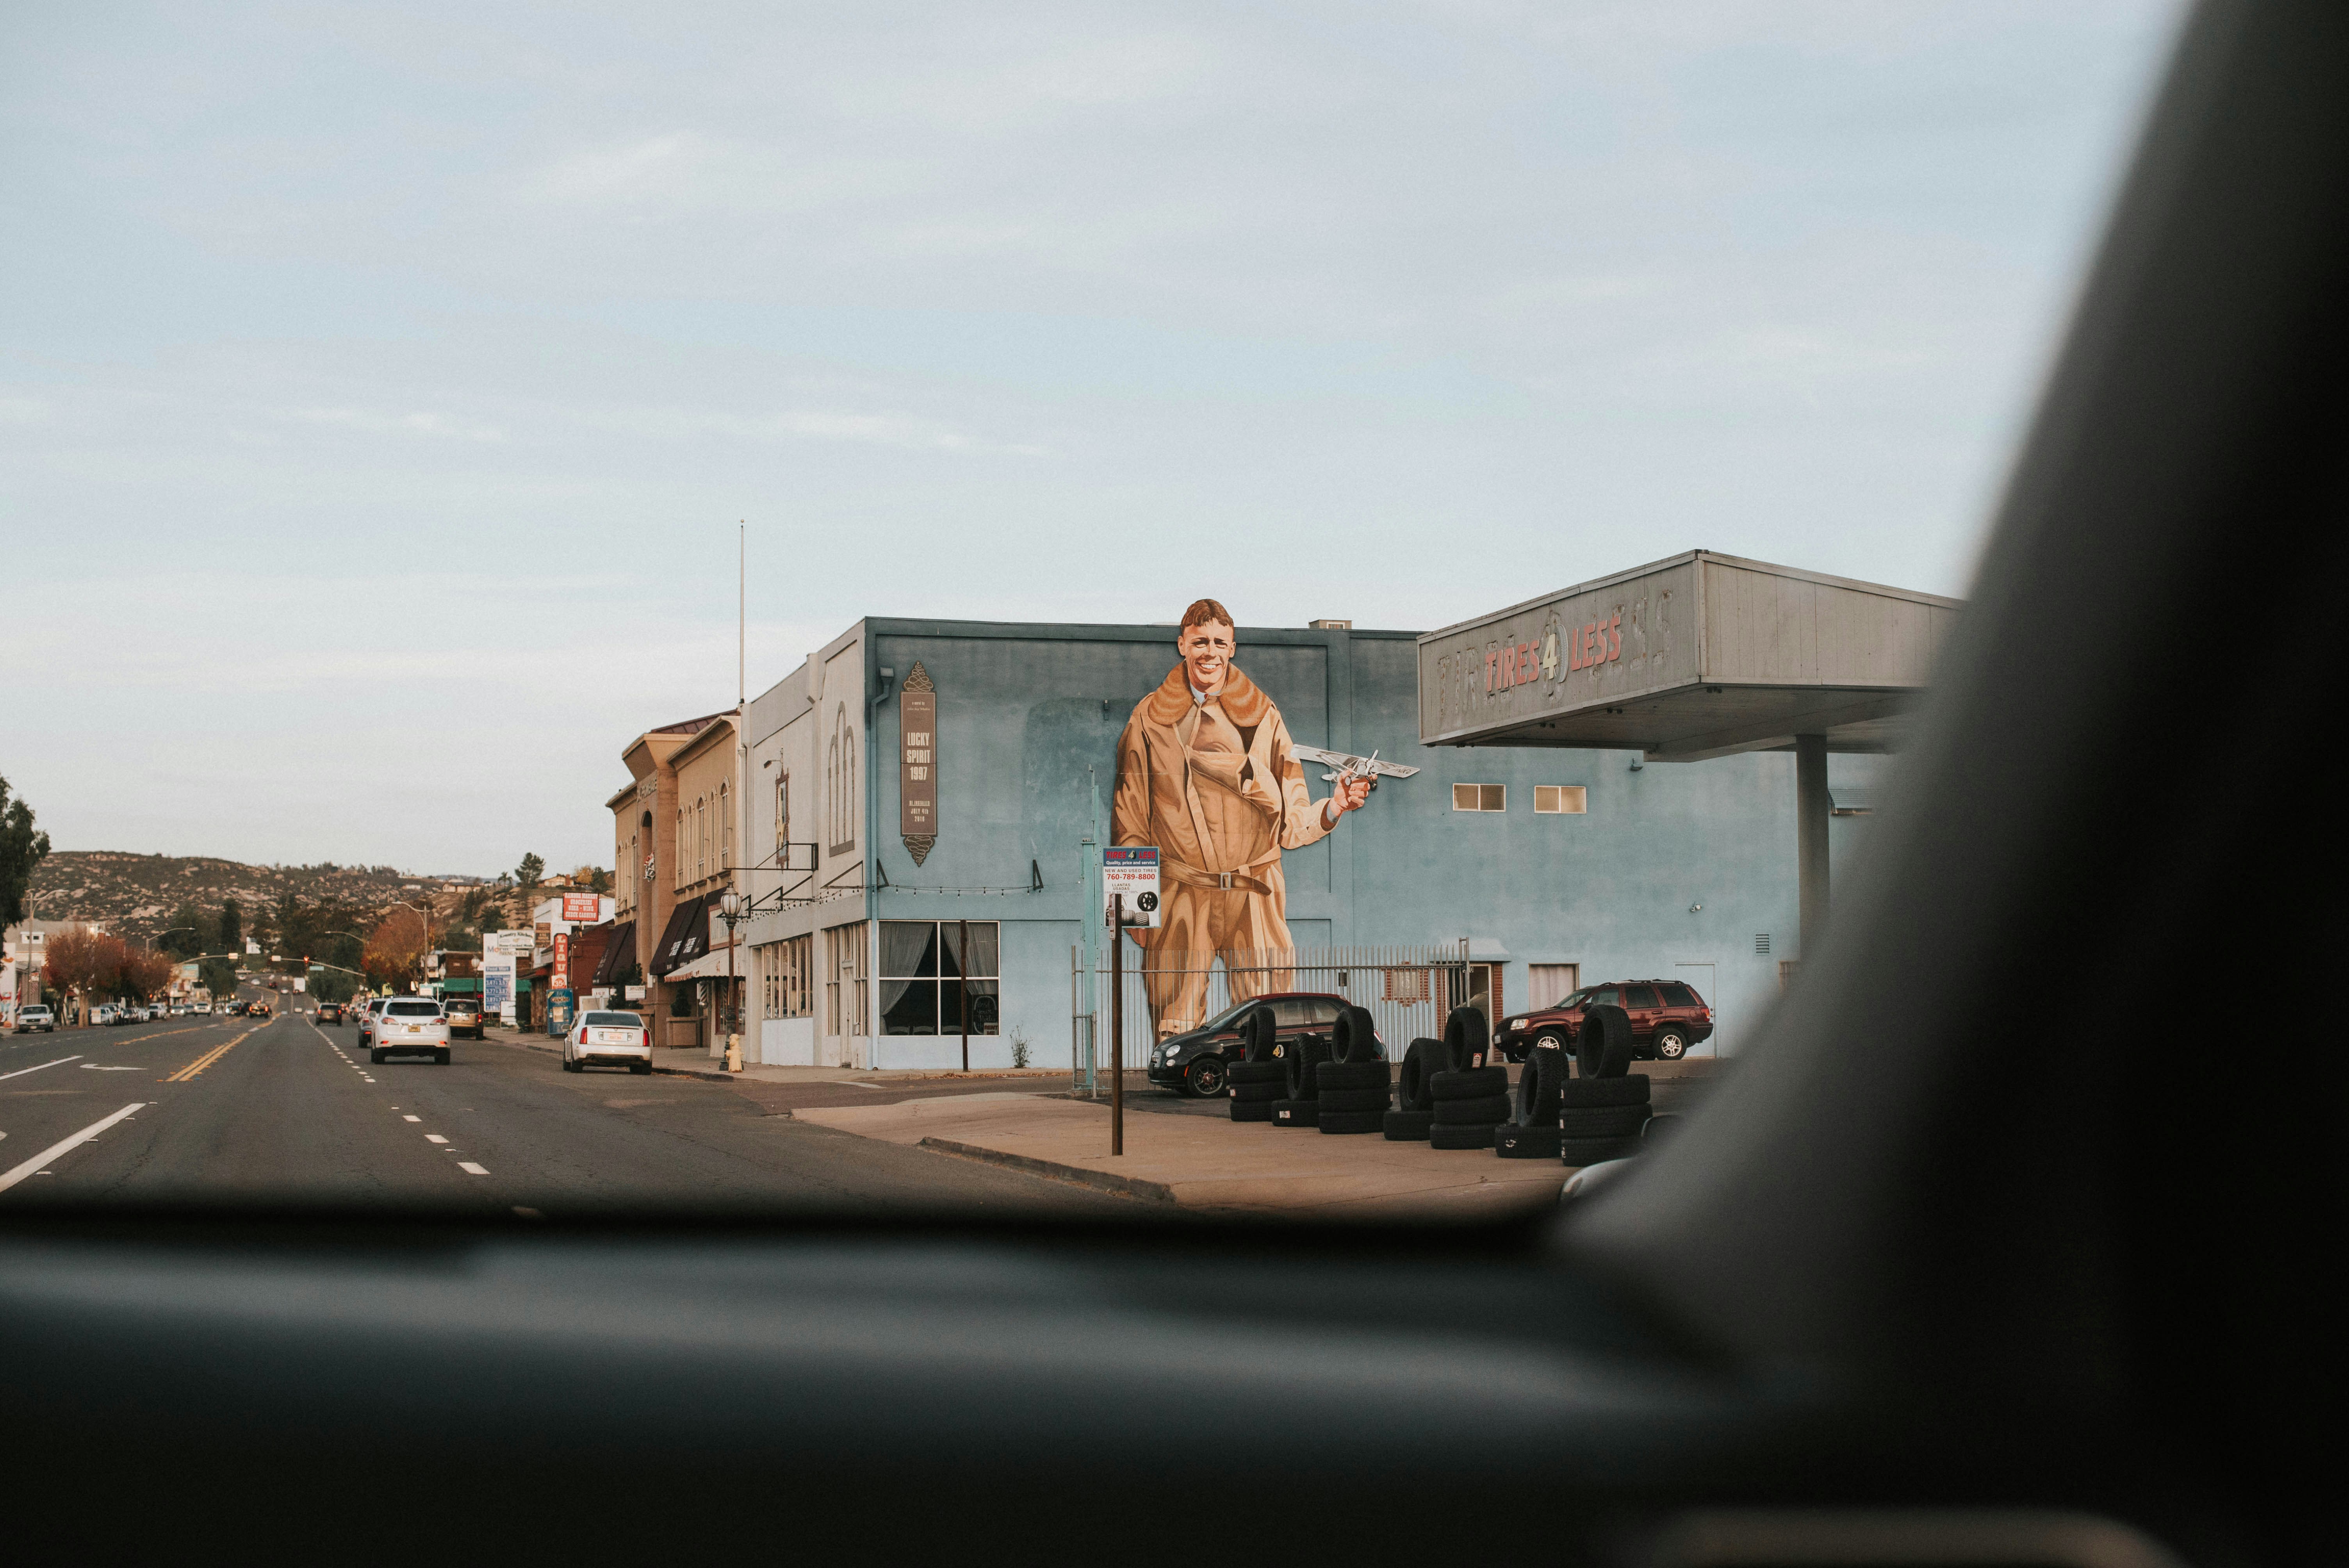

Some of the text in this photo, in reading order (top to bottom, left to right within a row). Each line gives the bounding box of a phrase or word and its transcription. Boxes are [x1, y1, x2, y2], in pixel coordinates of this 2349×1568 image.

[1485, 639, 1539, 692] TIRES
[1543, 633, 1557, 680] 4
[1571, 615, 1620, 671] LESS
[907, 732, 929, 746] LUCKY
[907, 749, 930, 763] SPIRIT
[910, 766, 927, 780] 1997
[1128, 850, 1134, 859] 4
